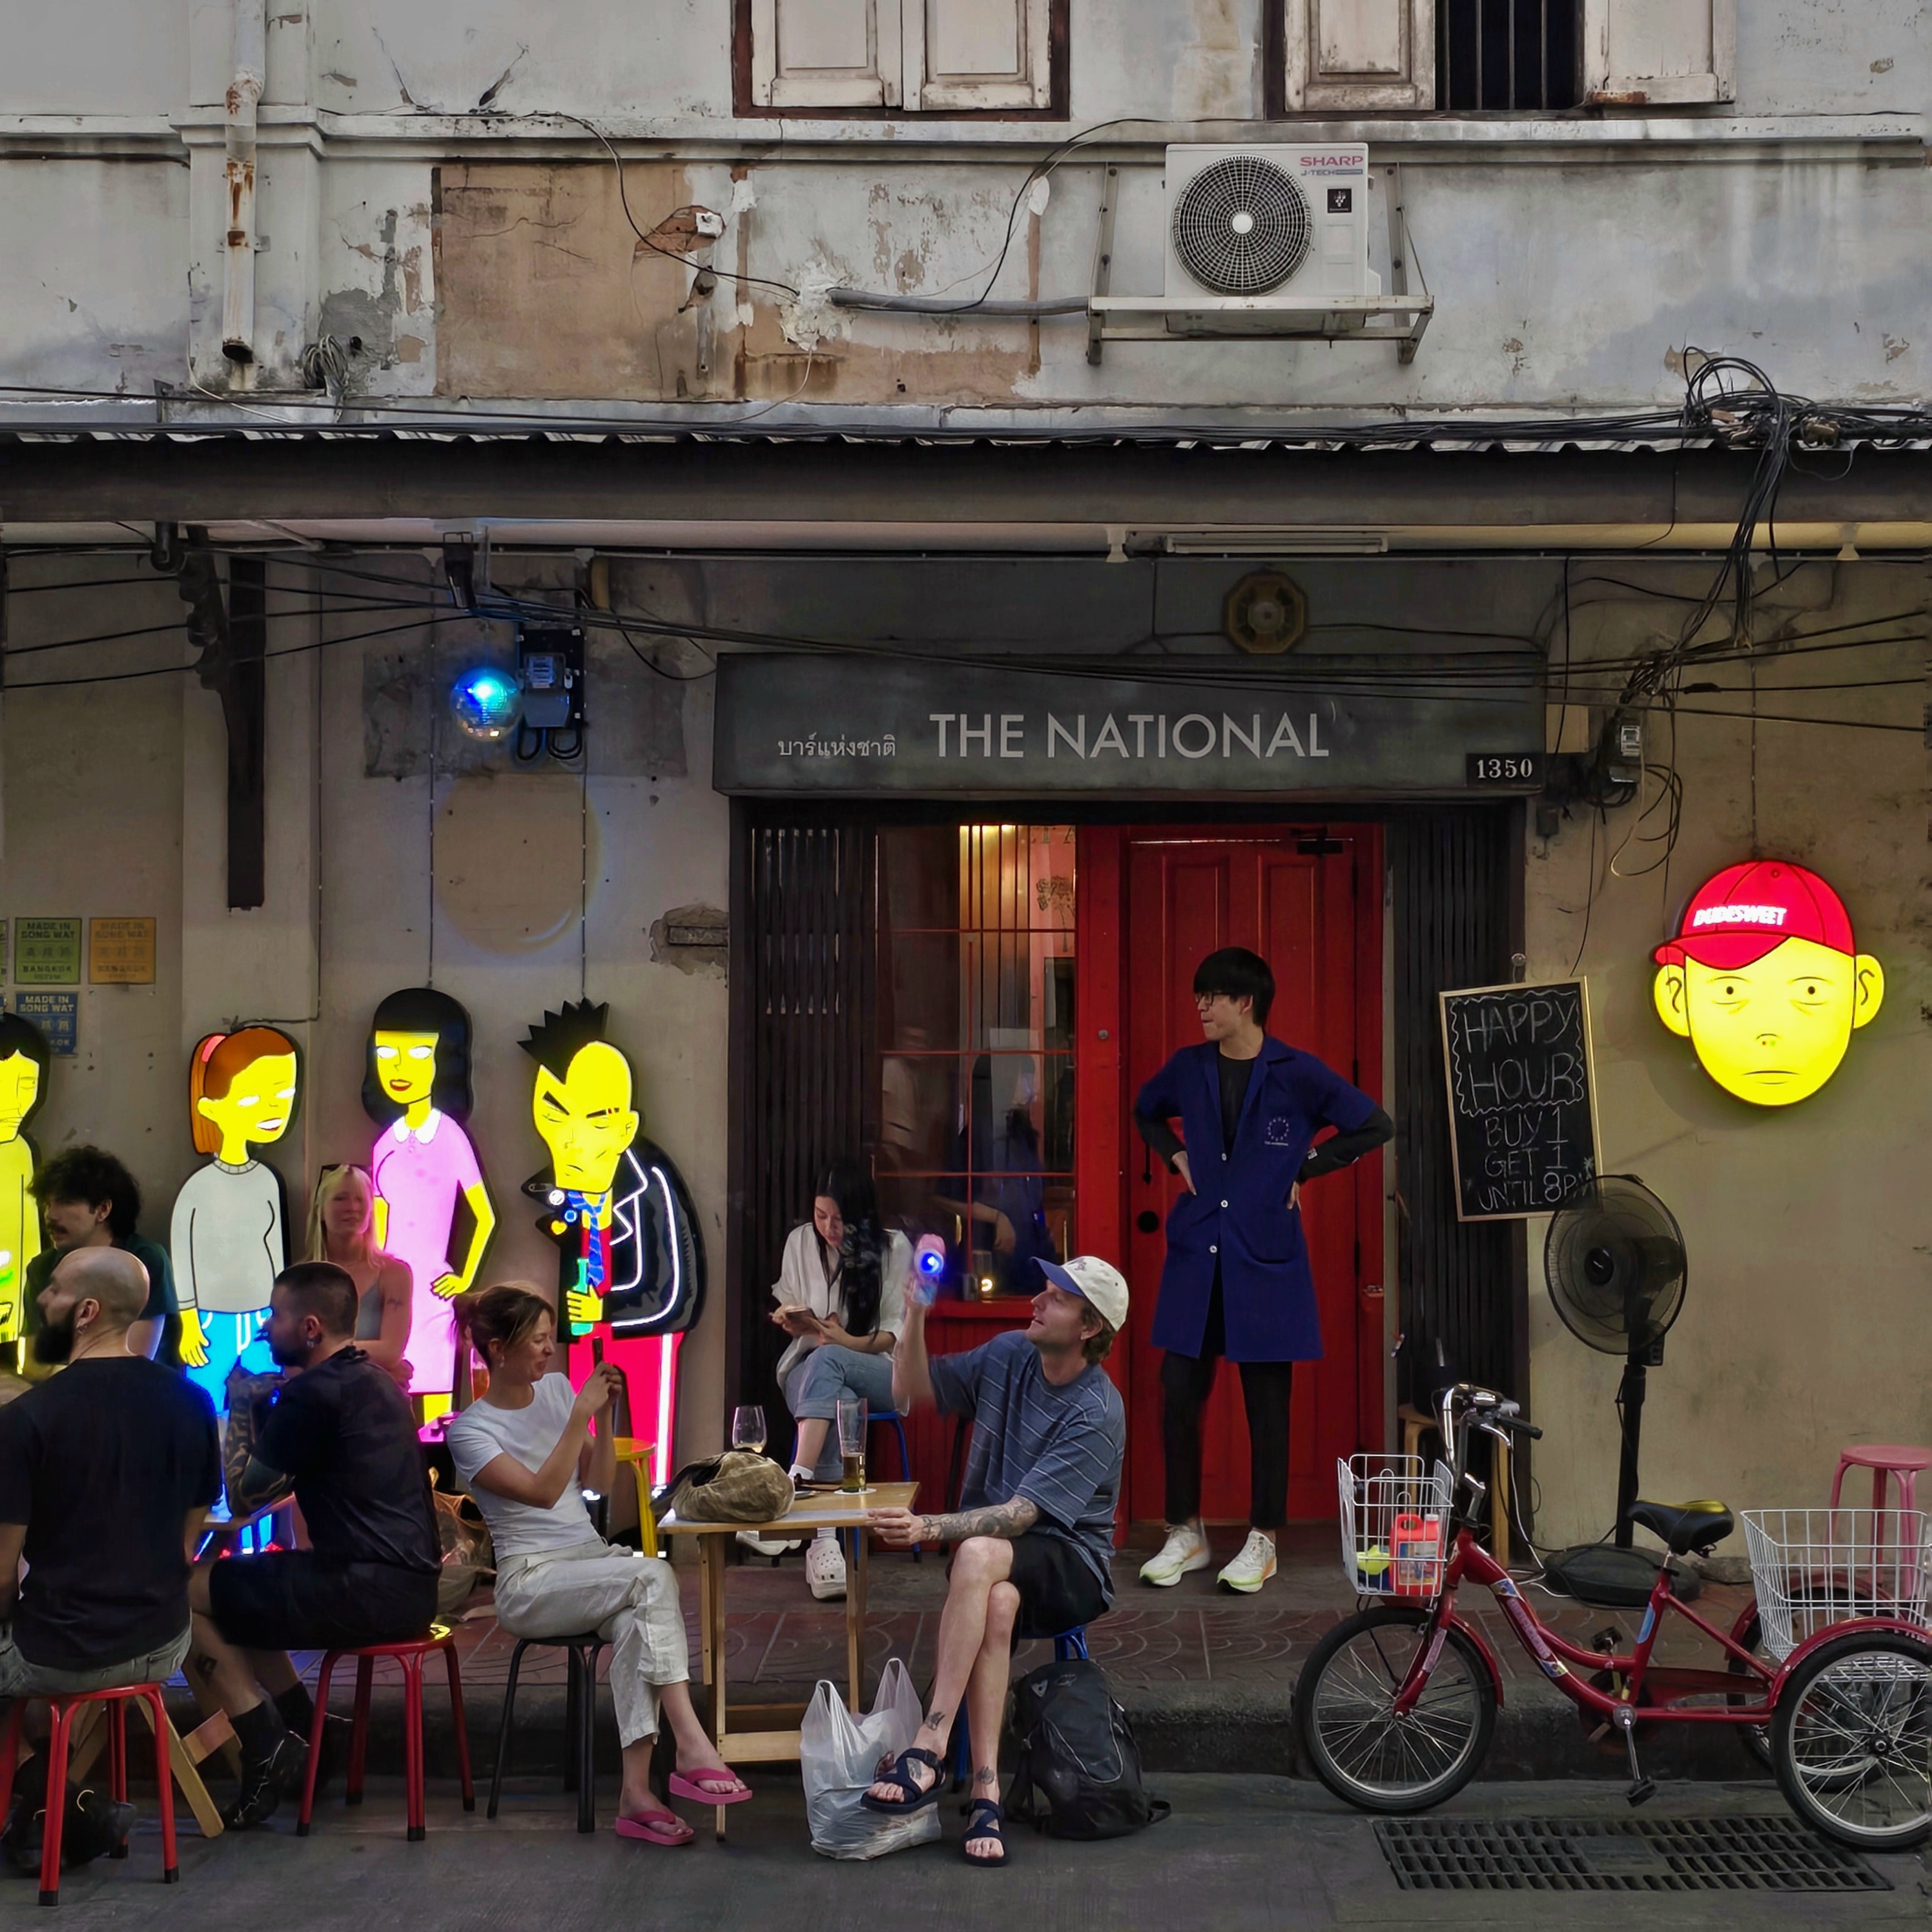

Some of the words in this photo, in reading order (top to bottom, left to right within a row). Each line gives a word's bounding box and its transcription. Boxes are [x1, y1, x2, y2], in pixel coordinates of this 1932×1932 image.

[1300, 156, 1363, 166] SHARP
[777, 732, 896, 758] บาร์แห่งชาติ
[929, 714, 1024, 758] THE
[1047, 712, 1330, 759] NATIONAL
[1477, 758, 1532, 778] 1350
[20, 1004, 48, 1012] SONG
[52, 1004, 74, 1012] WAT
[1463, 1000, 1576, 1053] HAPPY
[1468, 1053, 1576, 1109] HOUR
[1485, 1111, 1543, 1147] BUY
[1546, 1105, 1568, 1144] 1
[1485, 1147, 1539, 1178] GET
[1545, 1144, 1568, 1169] 1
[1478, 1180, 1543, 1211] UNTIL
